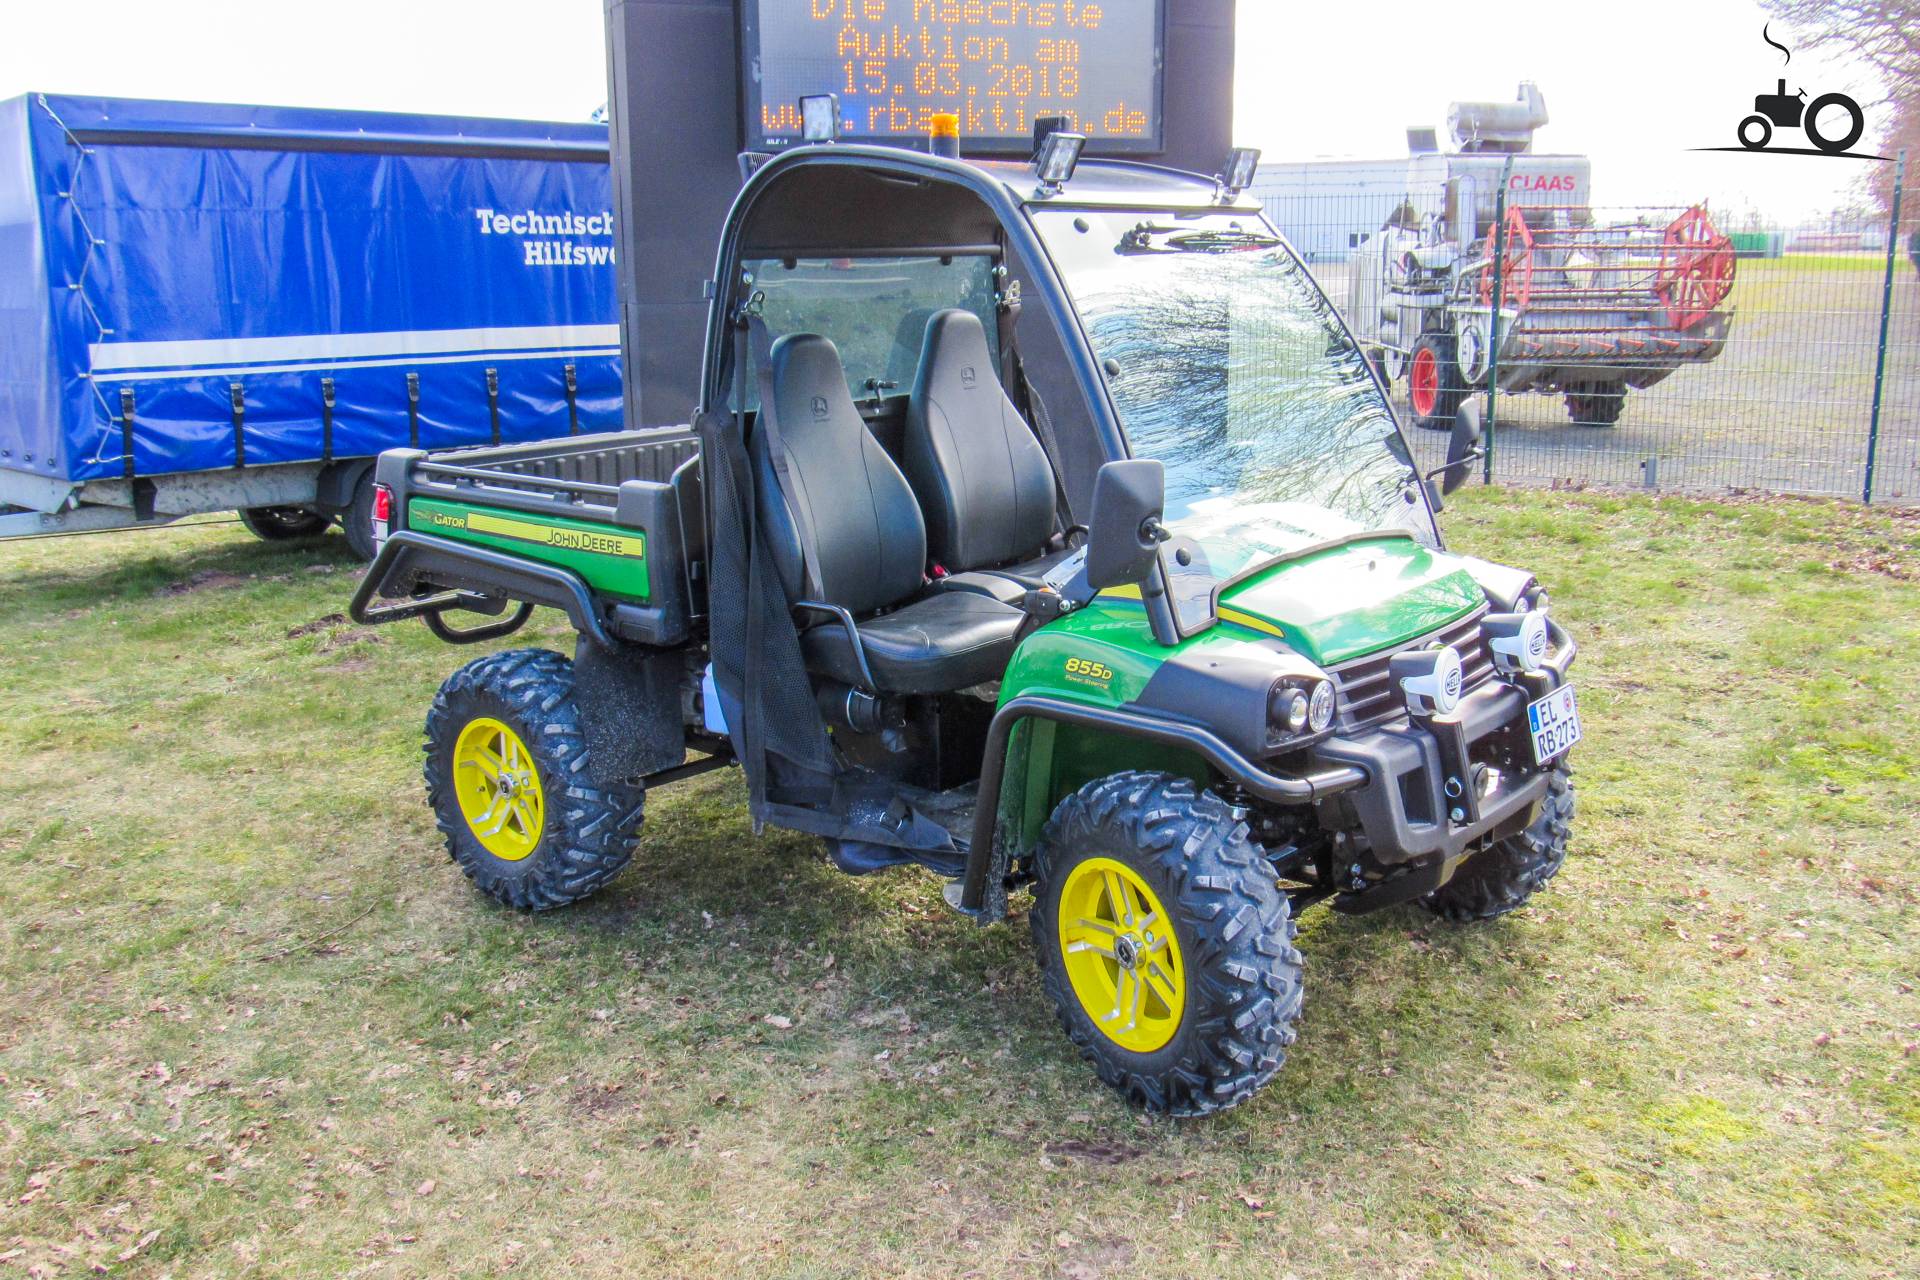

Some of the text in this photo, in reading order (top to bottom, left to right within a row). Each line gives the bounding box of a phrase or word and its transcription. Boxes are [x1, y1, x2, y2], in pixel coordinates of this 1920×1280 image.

[811, 0, 886, 20] Die
[838, 23, 1080, 63] Auktion am
[843, 60, 1080, 97] 15.03.2018
[1510, 175, 1575, 191] CLAAS
[1540, 701, 1557, 727] EL
